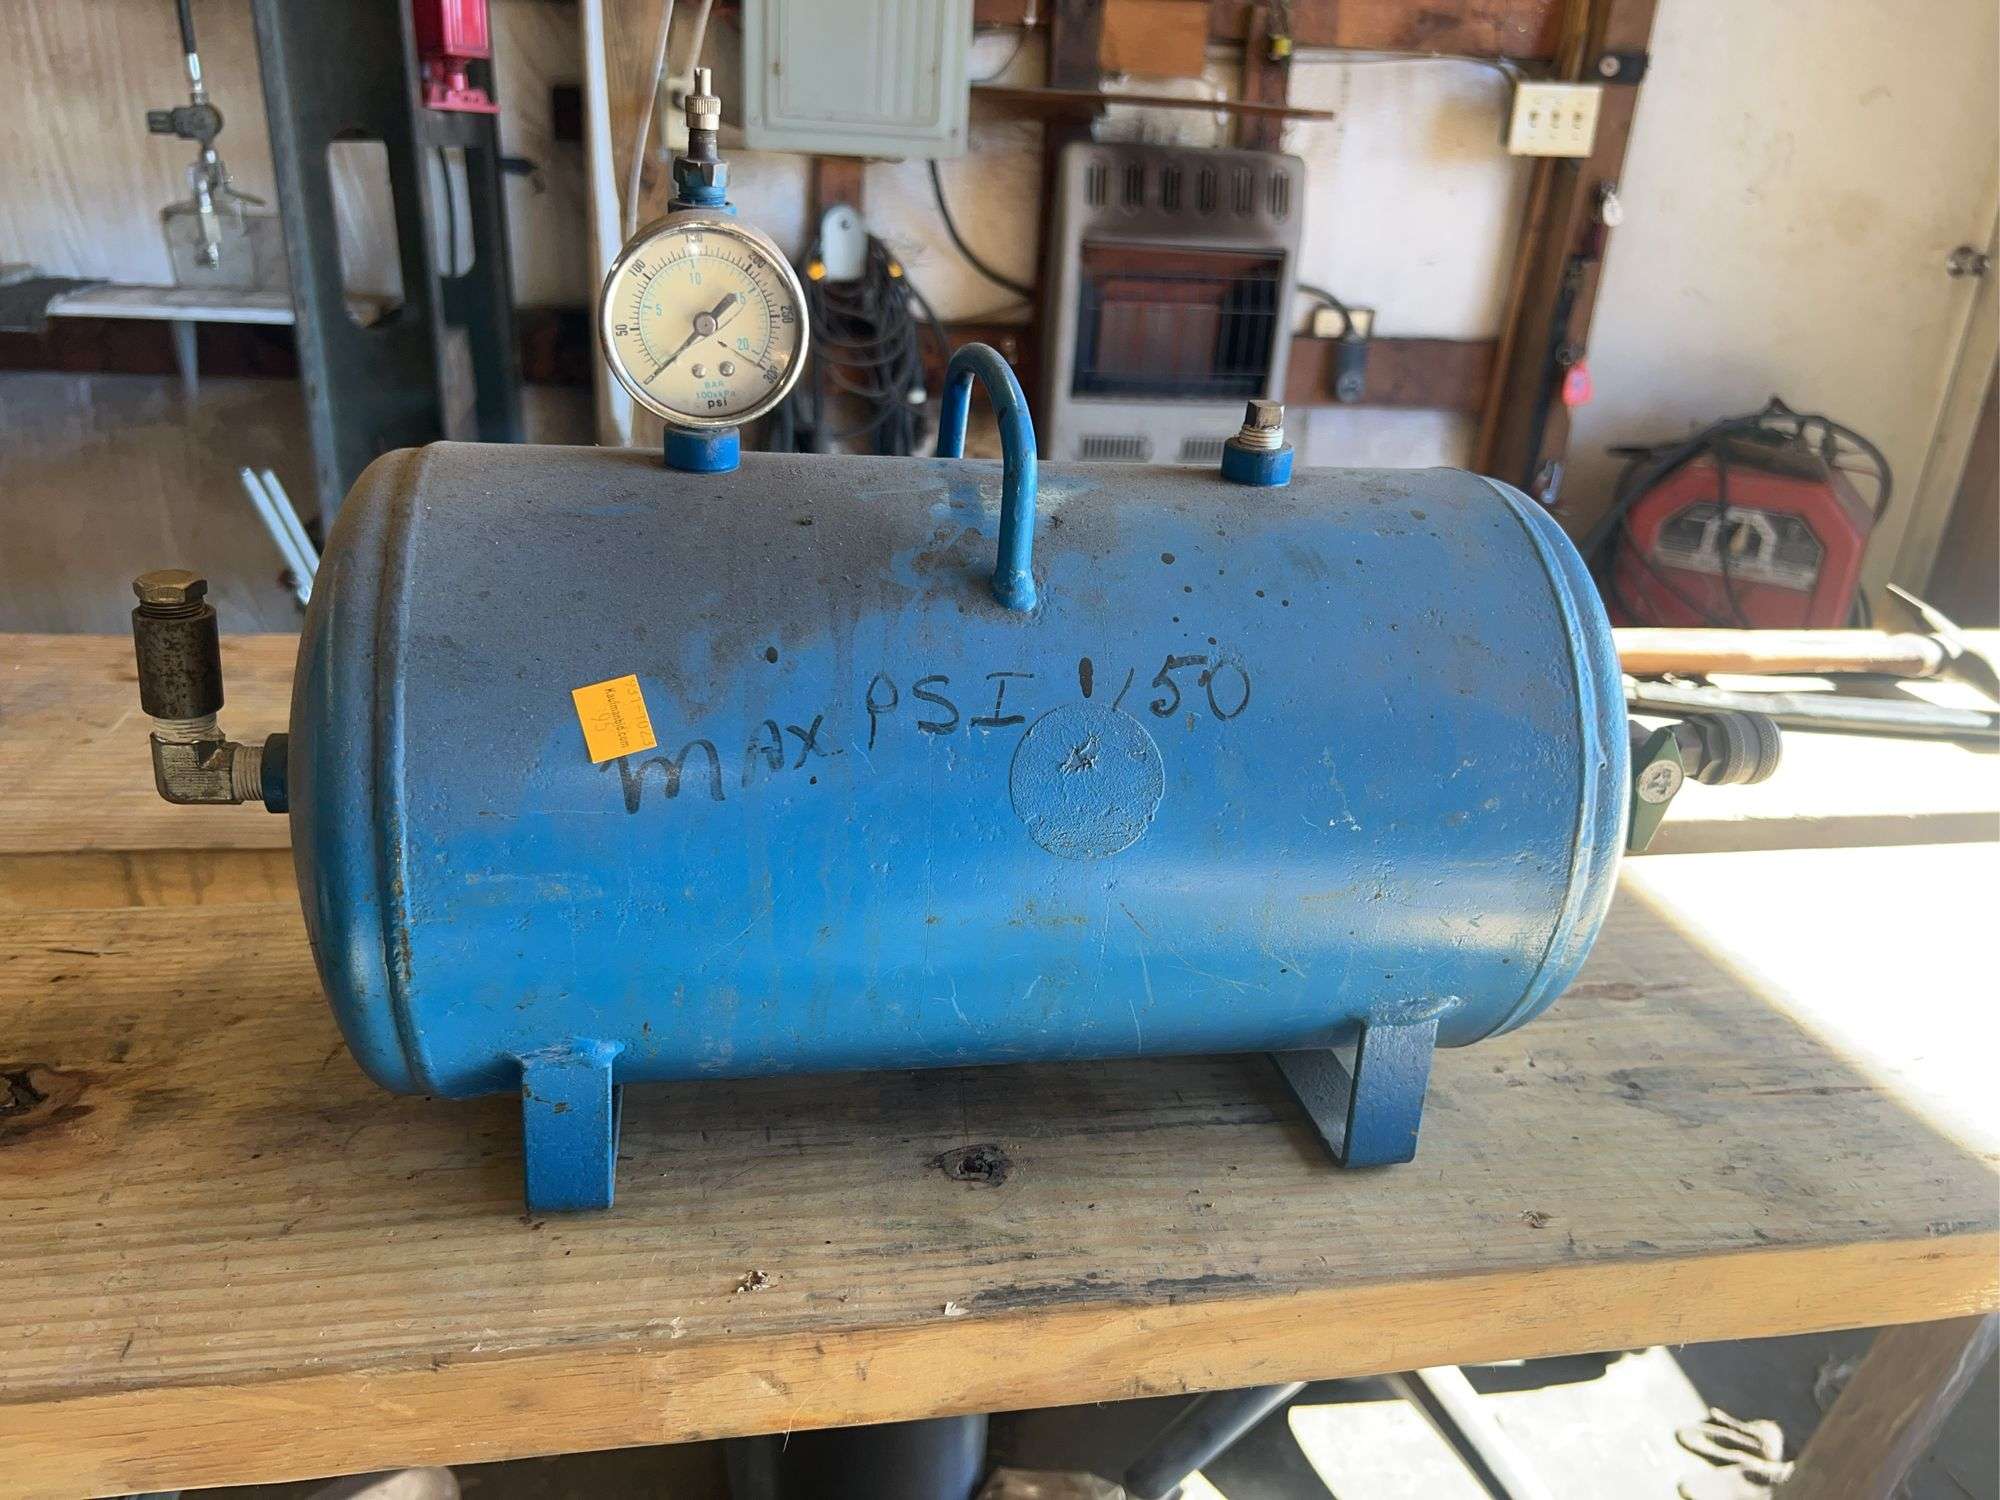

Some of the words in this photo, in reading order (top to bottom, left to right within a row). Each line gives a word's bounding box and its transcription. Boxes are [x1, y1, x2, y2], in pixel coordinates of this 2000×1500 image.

[749, 252, 766, 269] 200
[628, 259, 645, 276] 100
[690, 274, 702, 285] 10
[656, 304, 662, 316] 5
[780, 305, 794, 324] 250
[615, 324, 628, 337] 50
[737, 337, 748, 350] 20
[707, 398, 728, 409] psi
[866, 672, 1035, 750] PSI
